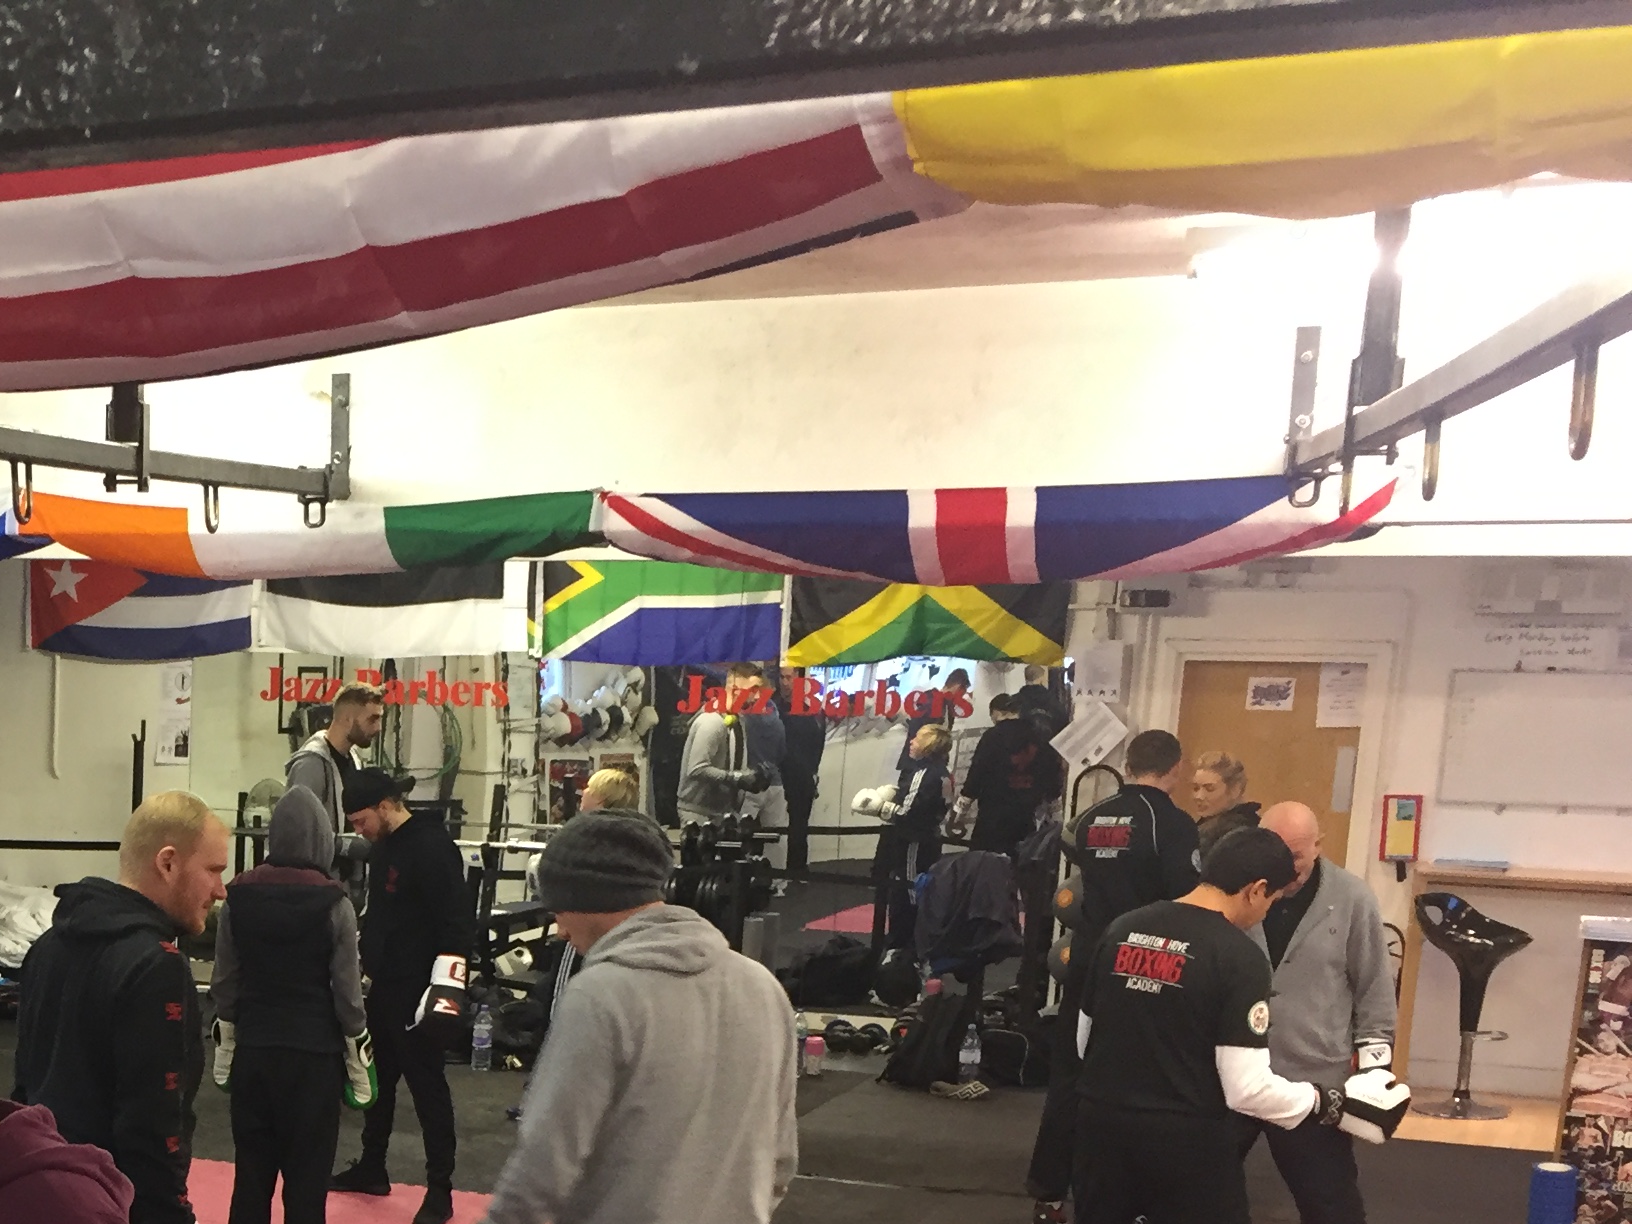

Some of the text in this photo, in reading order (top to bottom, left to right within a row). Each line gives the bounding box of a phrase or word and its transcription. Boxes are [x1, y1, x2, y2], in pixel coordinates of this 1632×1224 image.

[260, 666, 344, 703] Jazz
[676, 674, 974, 719] Jazz Barbers
[1127, 932, 1190, 953] BRIGHTON HOVE
[1113, 943, 1186, 984] BOXING
[1125, 977, 1163, 994] ACADEMY
